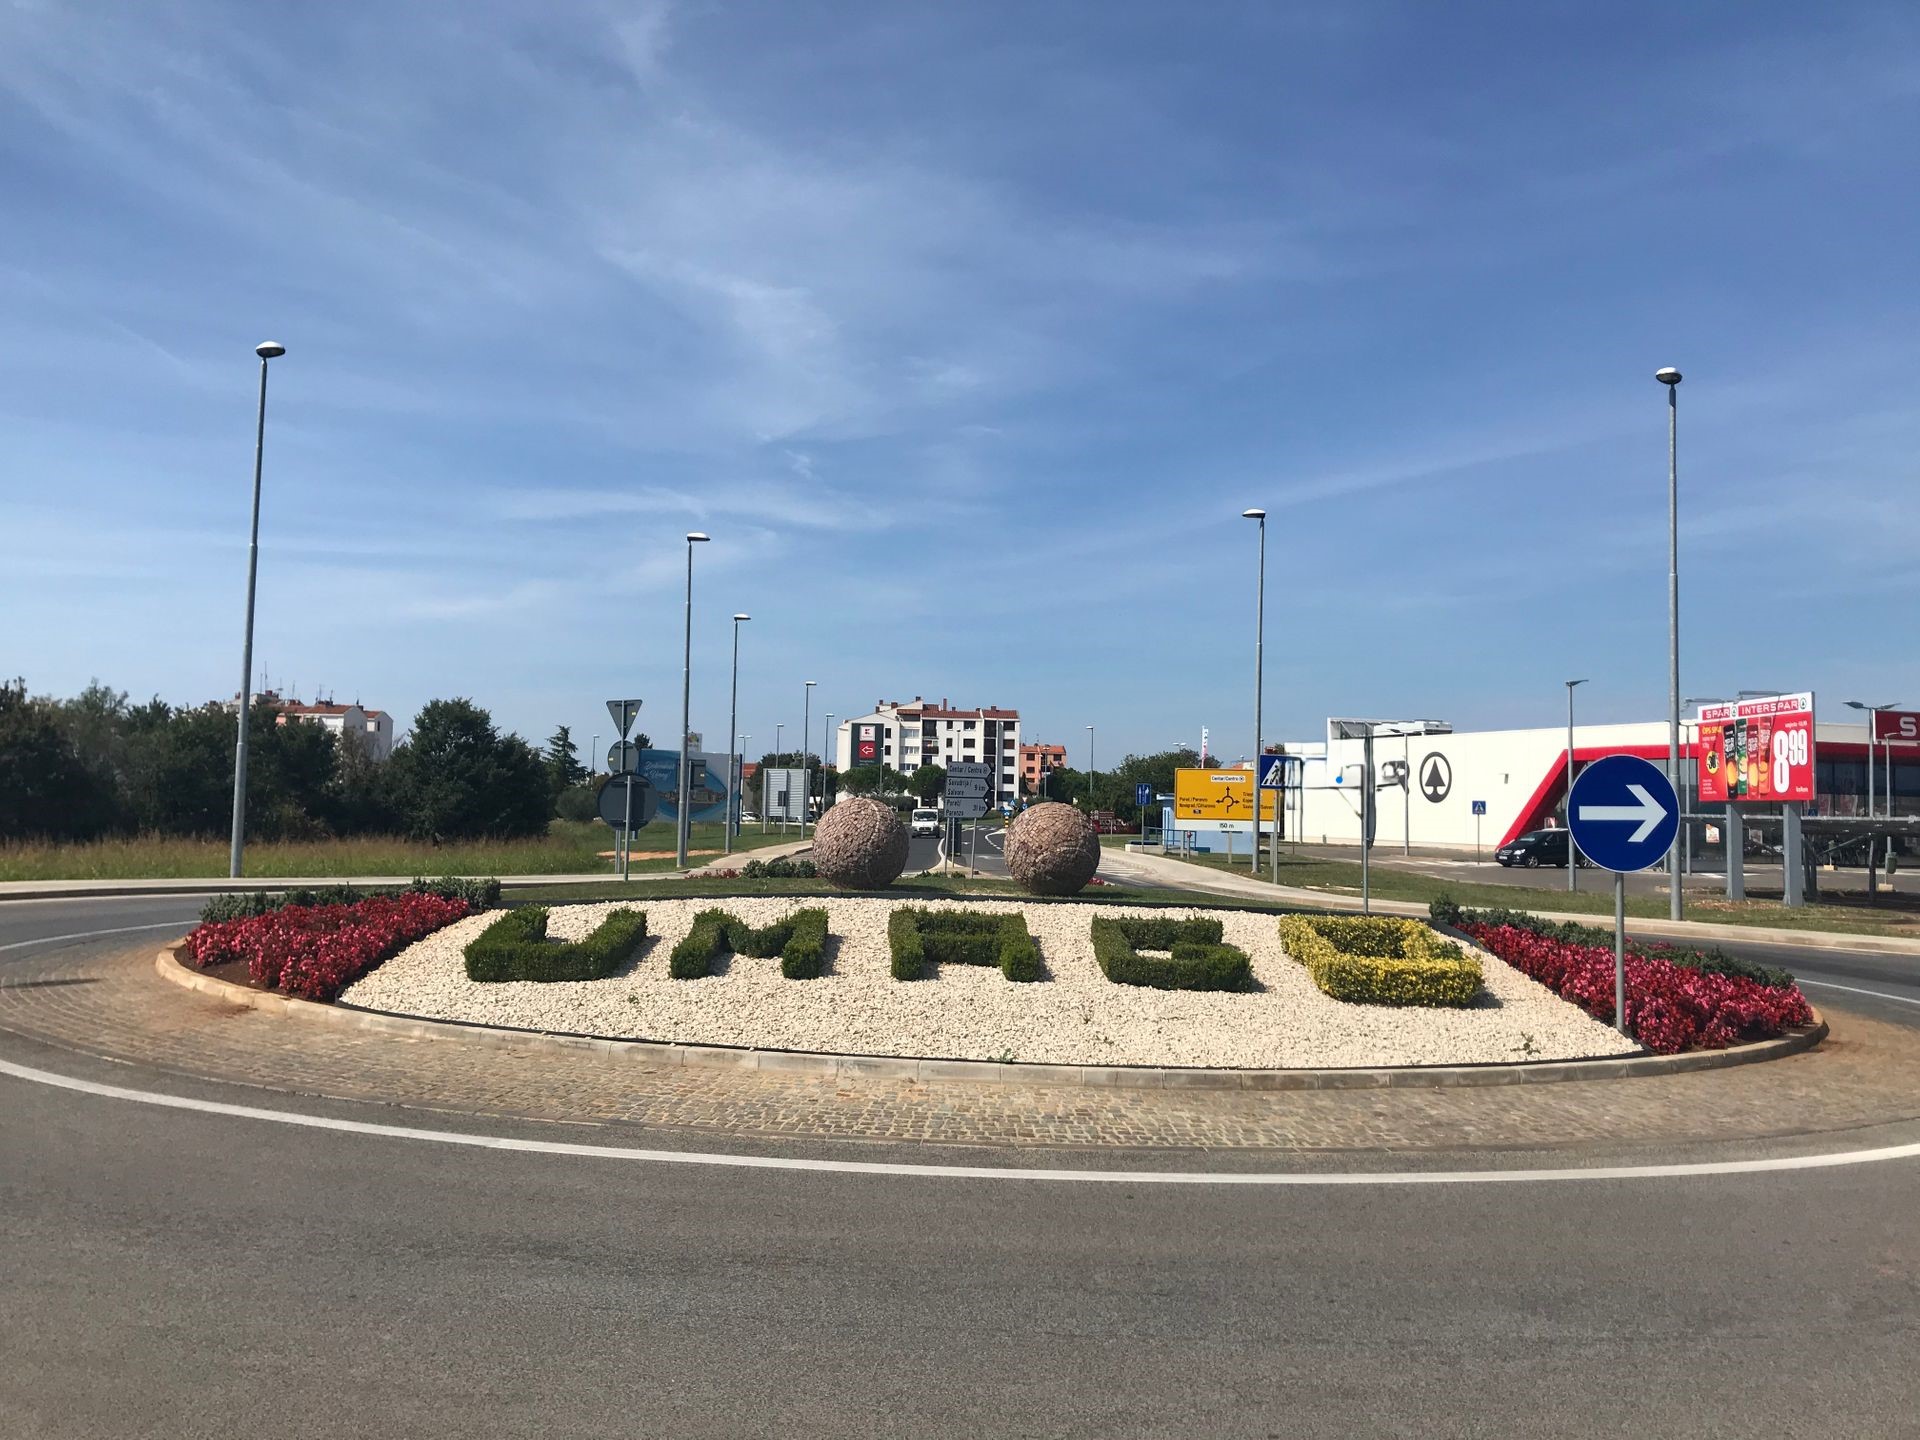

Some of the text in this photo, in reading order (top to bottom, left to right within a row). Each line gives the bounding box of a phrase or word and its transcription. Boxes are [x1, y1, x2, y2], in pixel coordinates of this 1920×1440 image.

[1705, 700, 1798, 719] SPAR INTERSPAR
[464, 904, 1484, 1007] UMAGO
